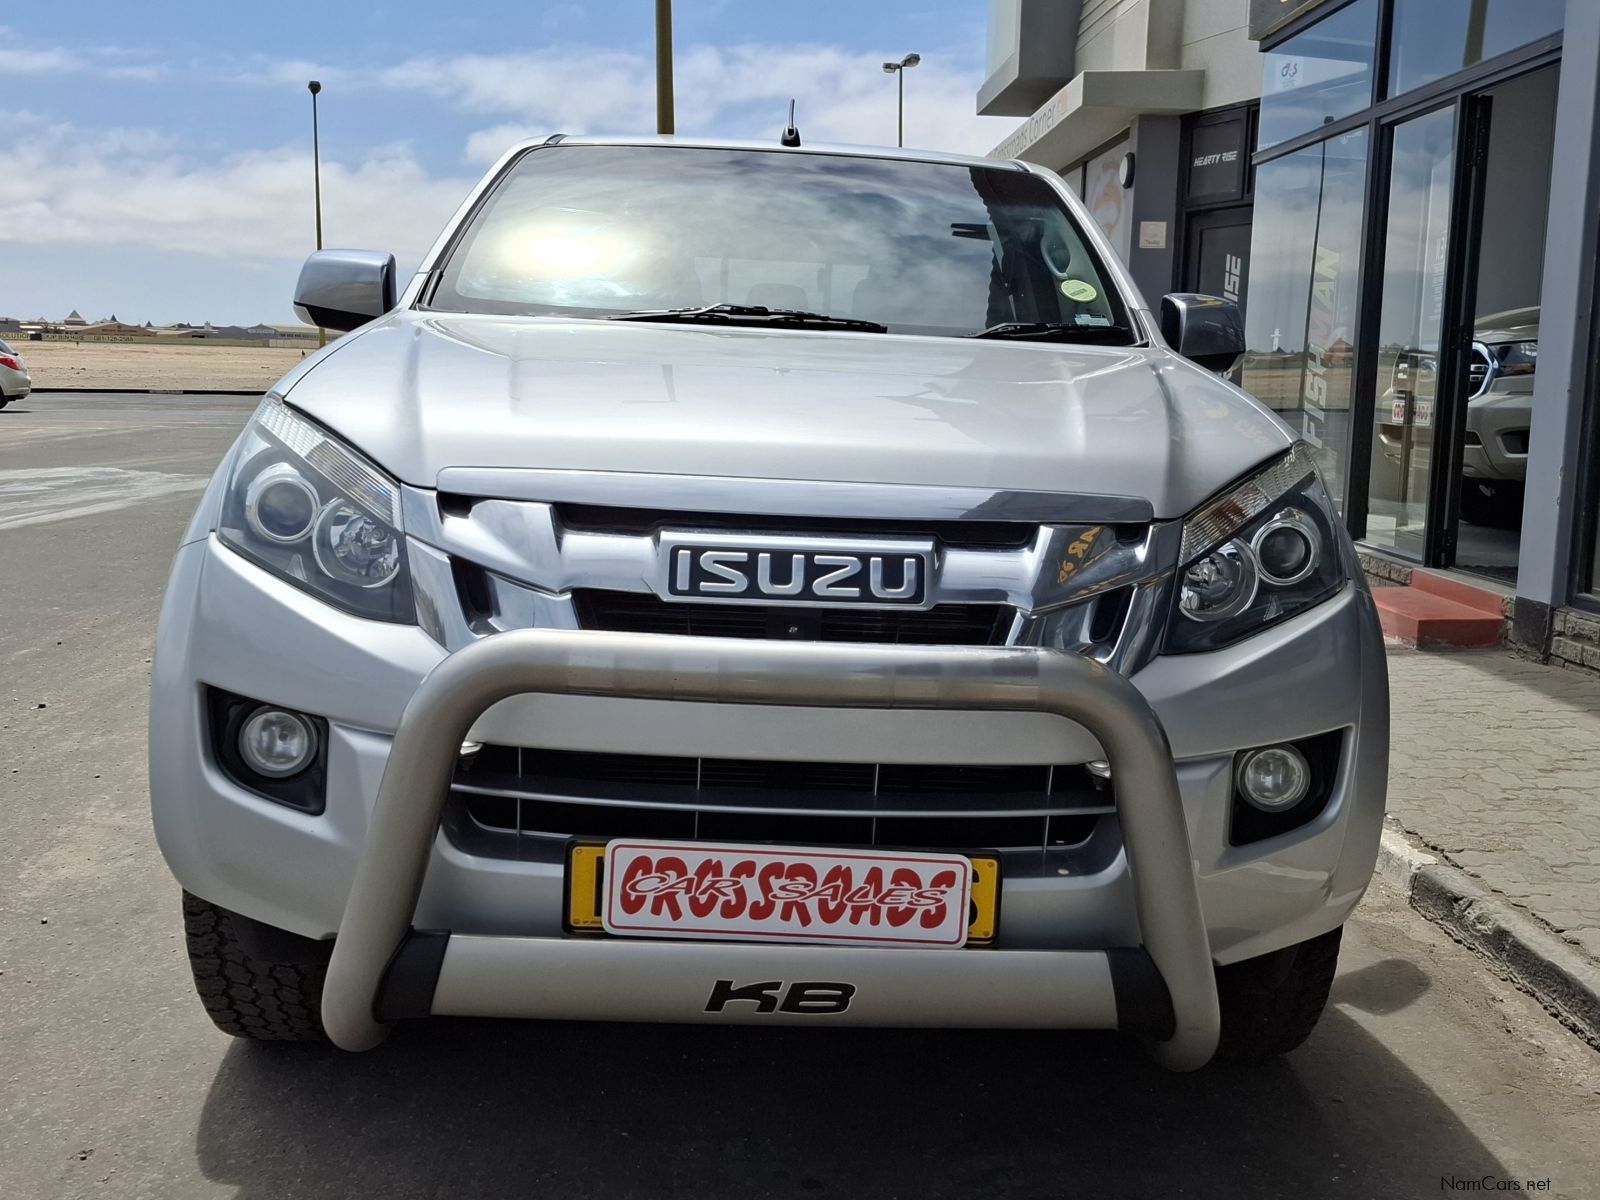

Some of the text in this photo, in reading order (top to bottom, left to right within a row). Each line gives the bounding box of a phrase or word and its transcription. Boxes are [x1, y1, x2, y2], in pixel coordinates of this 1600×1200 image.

[1030, 103, 1056, 144] Corner
[1193, 150, 1239, 167] HEARTY RISE
[1223, 253, 1241, 302] ISE
[676, 549, 917, 599] ISUZU
[619, 854, 957, 930] CROSSROADS
[626, 873, 744, 898] CAR
[769, 880, 949, 908] SALES
[703, 979, 857, 1015] KB
